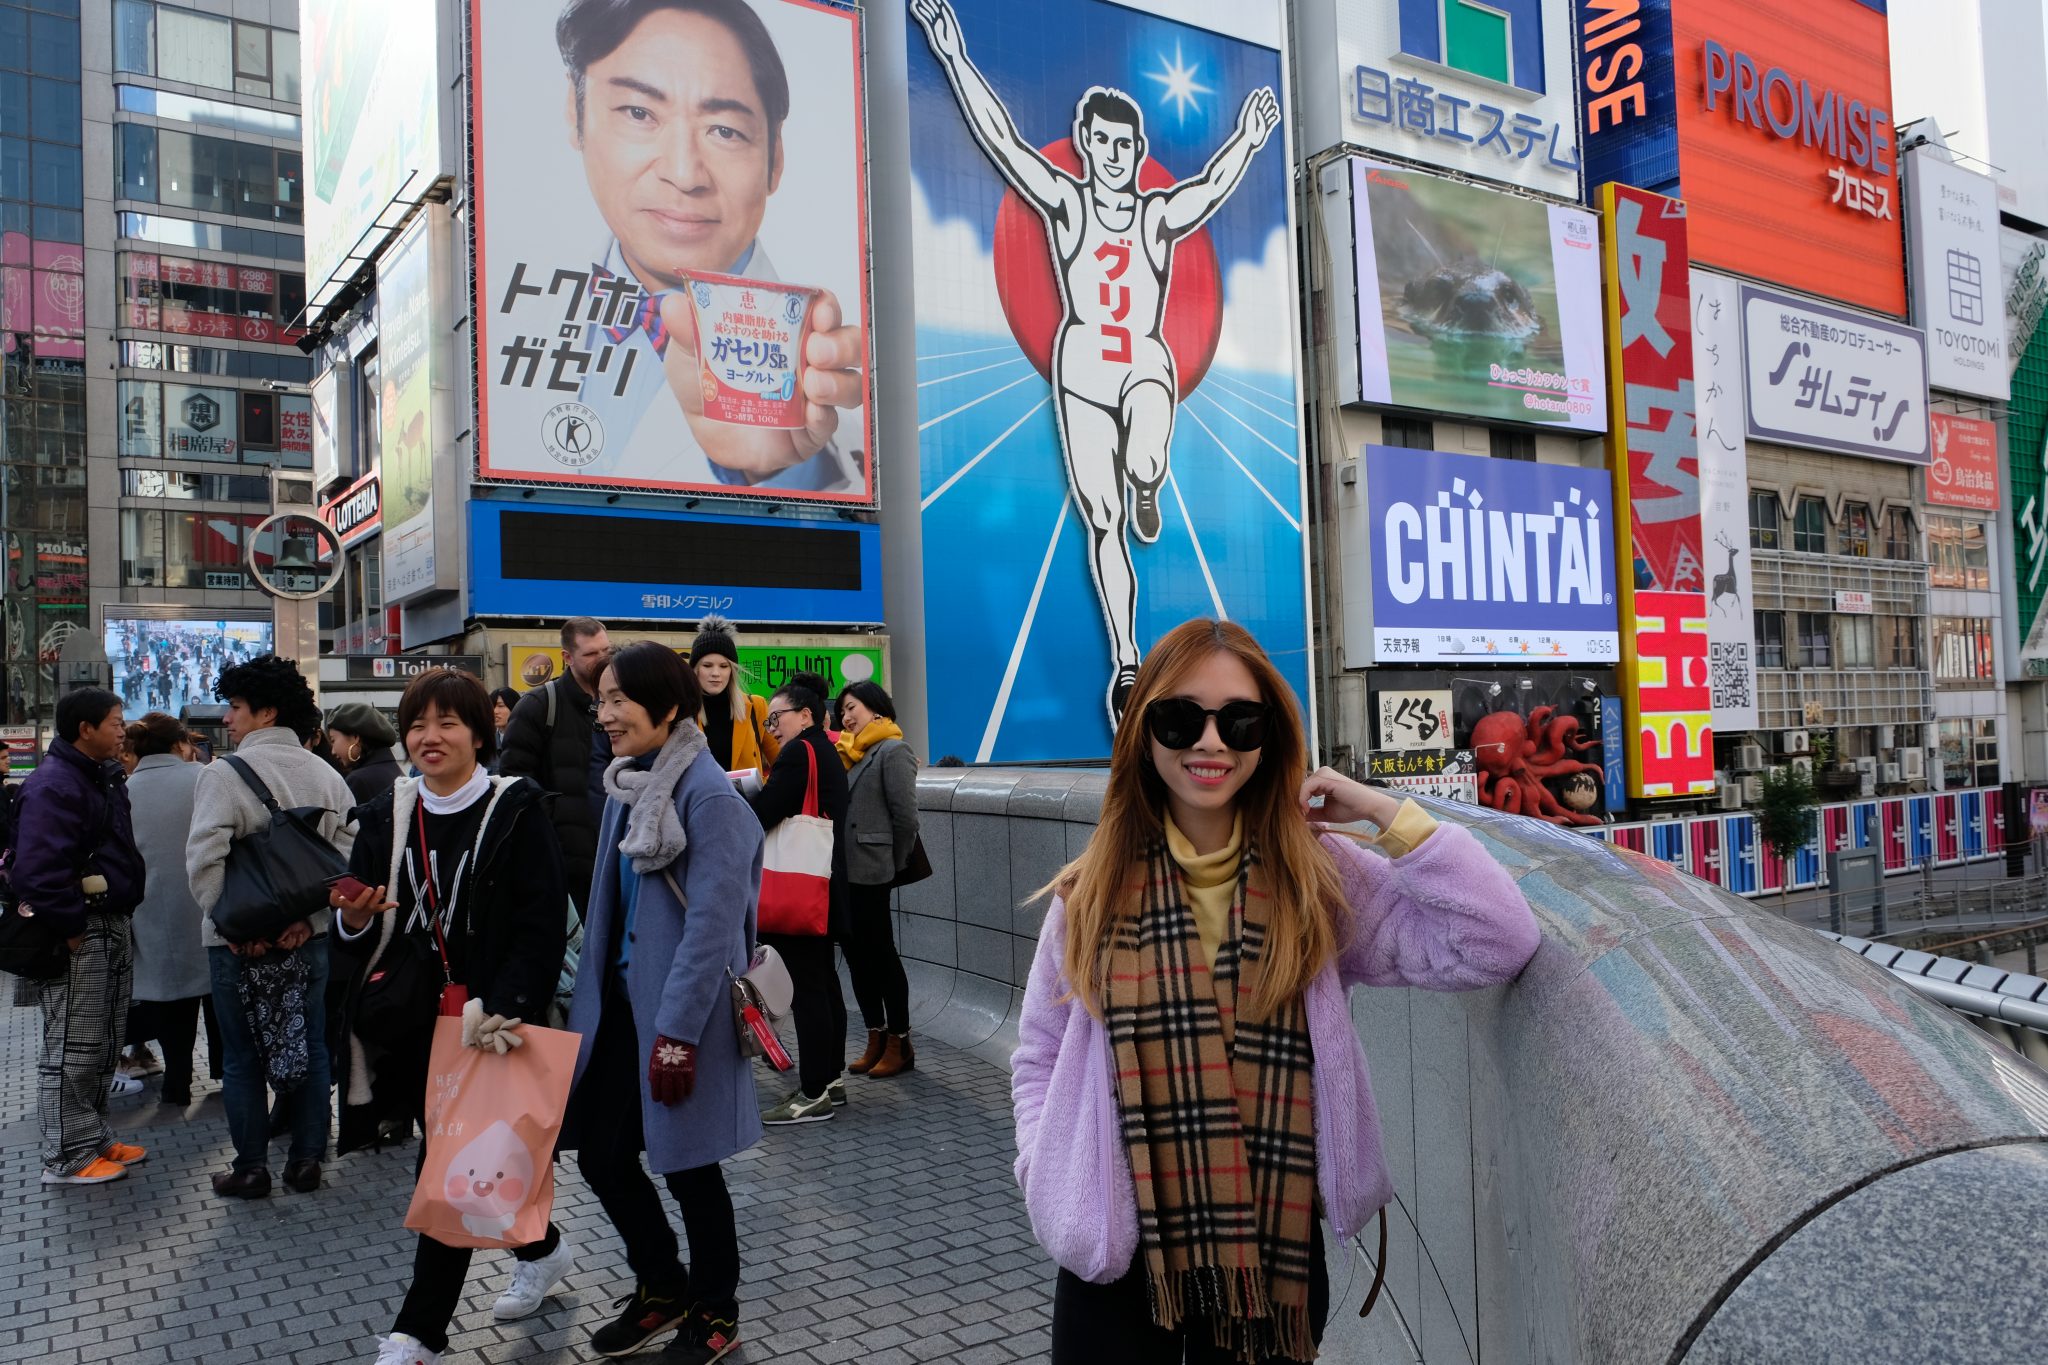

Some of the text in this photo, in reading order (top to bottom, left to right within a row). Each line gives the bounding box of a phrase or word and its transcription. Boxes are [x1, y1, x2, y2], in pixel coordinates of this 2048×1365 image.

[1356, 64, 1580, 171] 日商エステム
[1704, 39, 1890, 177] PROMISE
[1828, 166, 1892, 221] プロミス
[500, 262, 642, 329] トクホ
[740, 290, 757, 309] 恵
[1093, 239, 1132, 364] グリコ
[722, 312, 776, 329] 内臓脂肪を
[557, 324, 582, 340] の
[714, 322, 789, 342] 減らすのを助ける
[1780, 312, 1902, 355] 総合不動産のプロデューサー
[711, 336, 769, 366] ガセリ
[500, 334, 638, 396] ガセリ
[1953, 357, 1985, 371] HOLDINGS
[726, 369, 775, 385] ヨーグルト
[1490, 364, 1591, 392] ひょっこりカワウソで賞
[1524, 393, 1592, 414] @hotaru0809
[1794, 365, 1887, 421] サムティ
[281, 411, 310, 427] 女性
[758, 415, 778, 424] 100g
[168, 432, 227, 455] 相席屋
[281, 429, 310, 440] 飲み
[336, 484, 377, 532] LOTTERIA
[1385, 477, 1603, 605] CHINTAI
[207, 574, 239, 587] 営業時間
[641, 594, 733, 610] 雪印メグミルク
[1383, 637, 1420, 654] 天気予報
[1394, 698, 1440, 741] くくる
[1593, 697, 1601, 729] 2F
[1371, 755, 1447, 774] 大阪もんを食す
[1461, 764, 1473, 773] 2F
